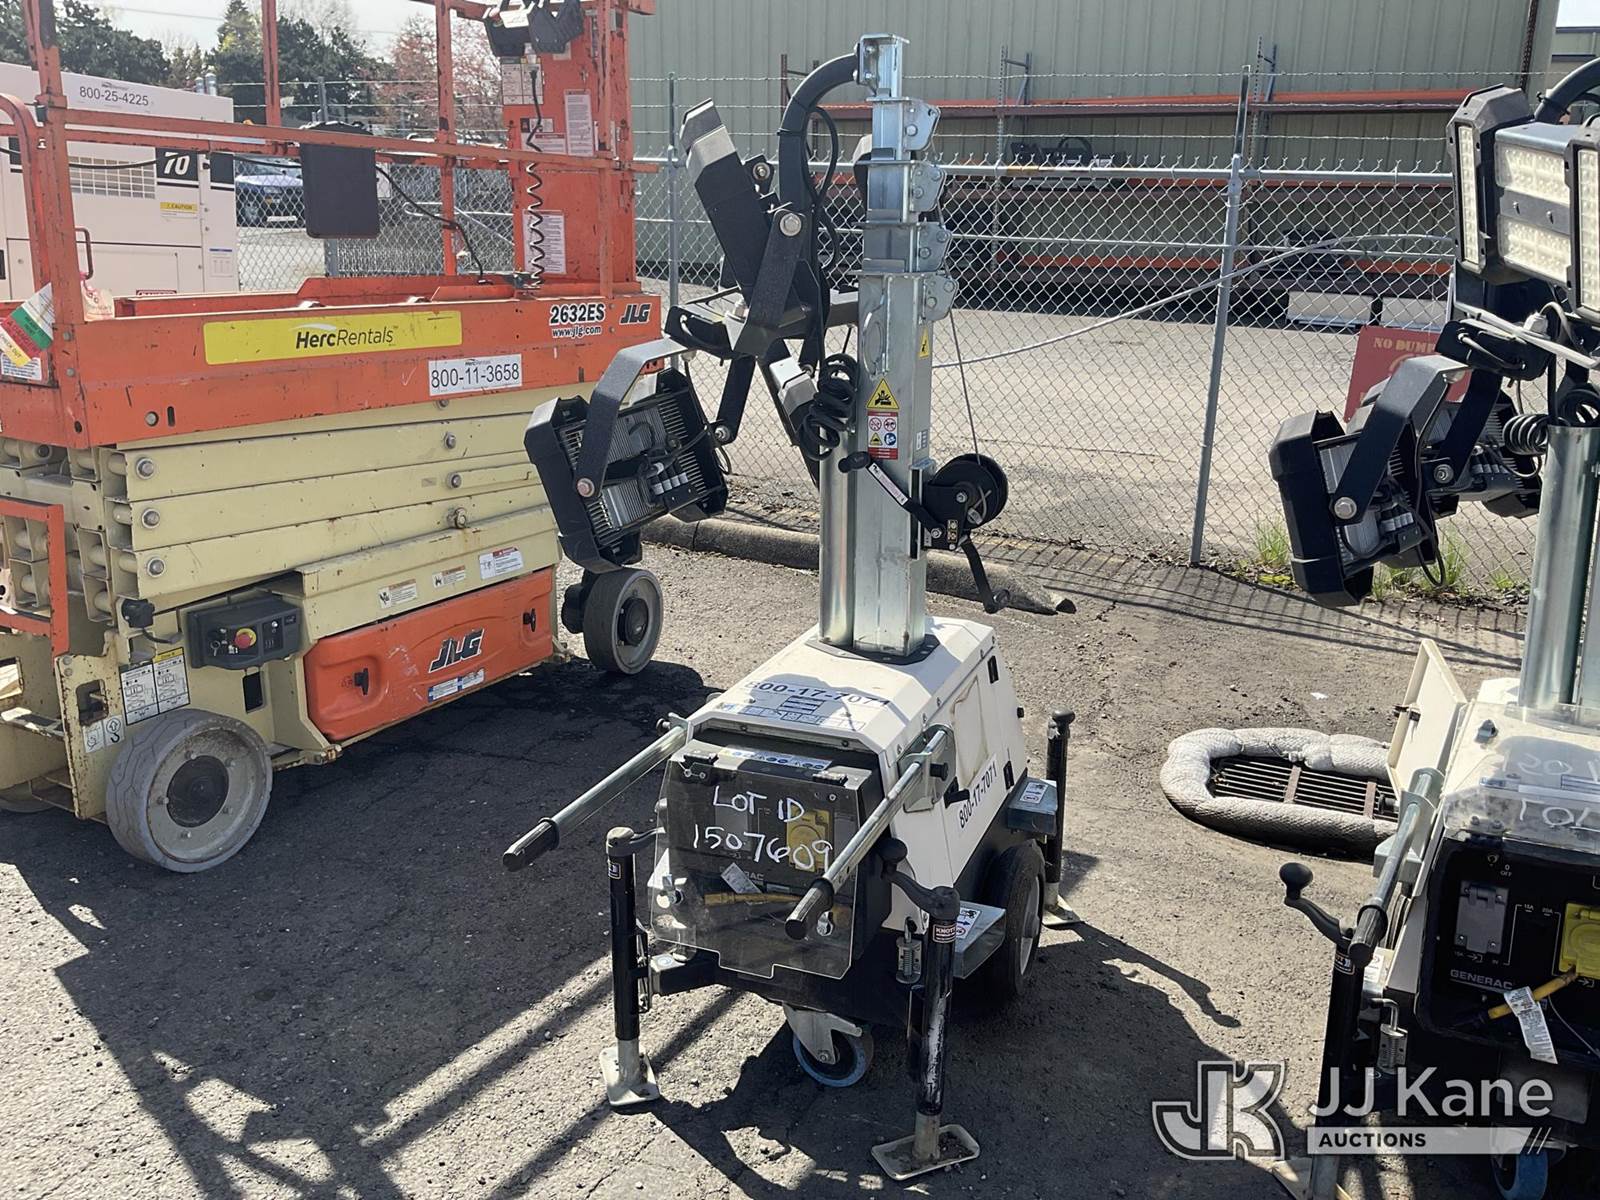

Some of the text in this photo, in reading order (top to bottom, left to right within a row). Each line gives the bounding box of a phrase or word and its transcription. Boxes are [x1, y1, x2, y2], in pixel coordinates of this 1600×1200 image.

[79, 86, 149, 107] 800-25-4225
[163, 151, 191, 176] 70
[550, 303, 605, 325] 2632ES
[620, 303, 651, 324] JLG
[296, 326, 394, 350] HercRentals
[552, 325, 602, 338] www.jlg.com
[1373, 337, 1393, 349] NO
[431, 363, 520, 389] 800-11-3658
[428, 628, 484, 673] JLG
[712, 785, 805, 823] LOT ID
[959, 761, 998, 829] 800-17-7071
[693, 823, 834, 873] 1507609
[1450, 969, 1514, 991] GENERAC
